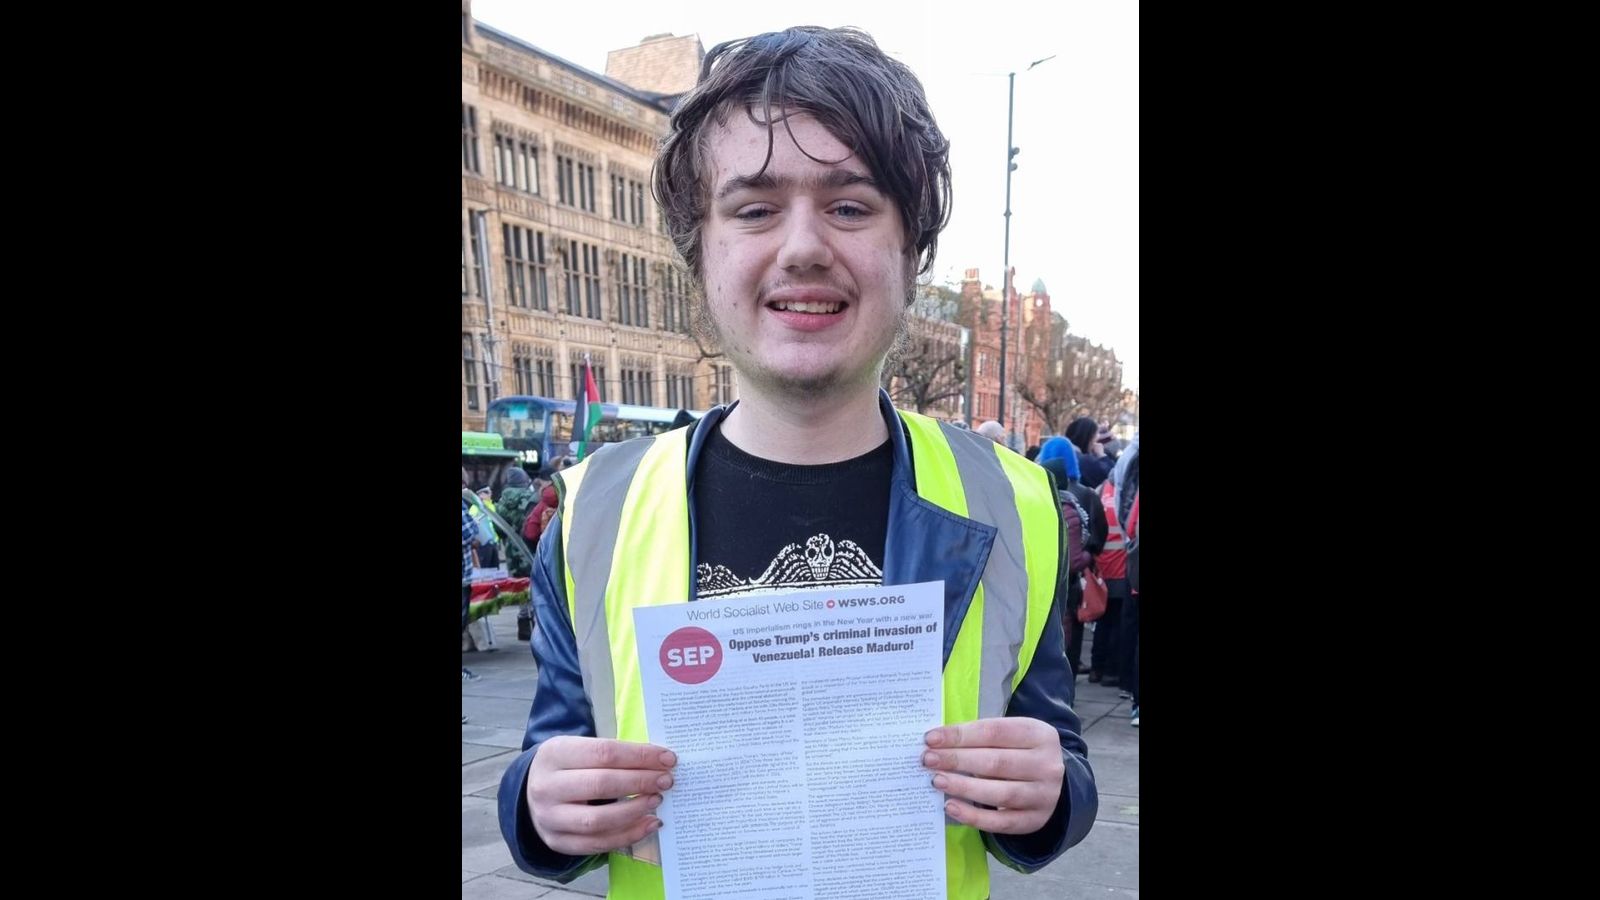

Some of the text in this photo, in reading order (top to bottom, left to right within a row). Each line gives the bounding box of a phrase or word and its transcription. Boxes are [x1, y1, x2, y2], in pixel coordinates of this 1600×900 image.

[687, 595, 905, 621] World Socialist Web Site WSWS.ORG
[746, 624, 791, 634] imperialism
[792, 621, 812, 630] rings
[875, 615, 892, 623] with
[729, 622, 938, 651] Oppose Trump's criminal invasion of
[667, 645, 715, 667] SEP
[752, 640, 914, 663] Venezuela! Release Maduro!
